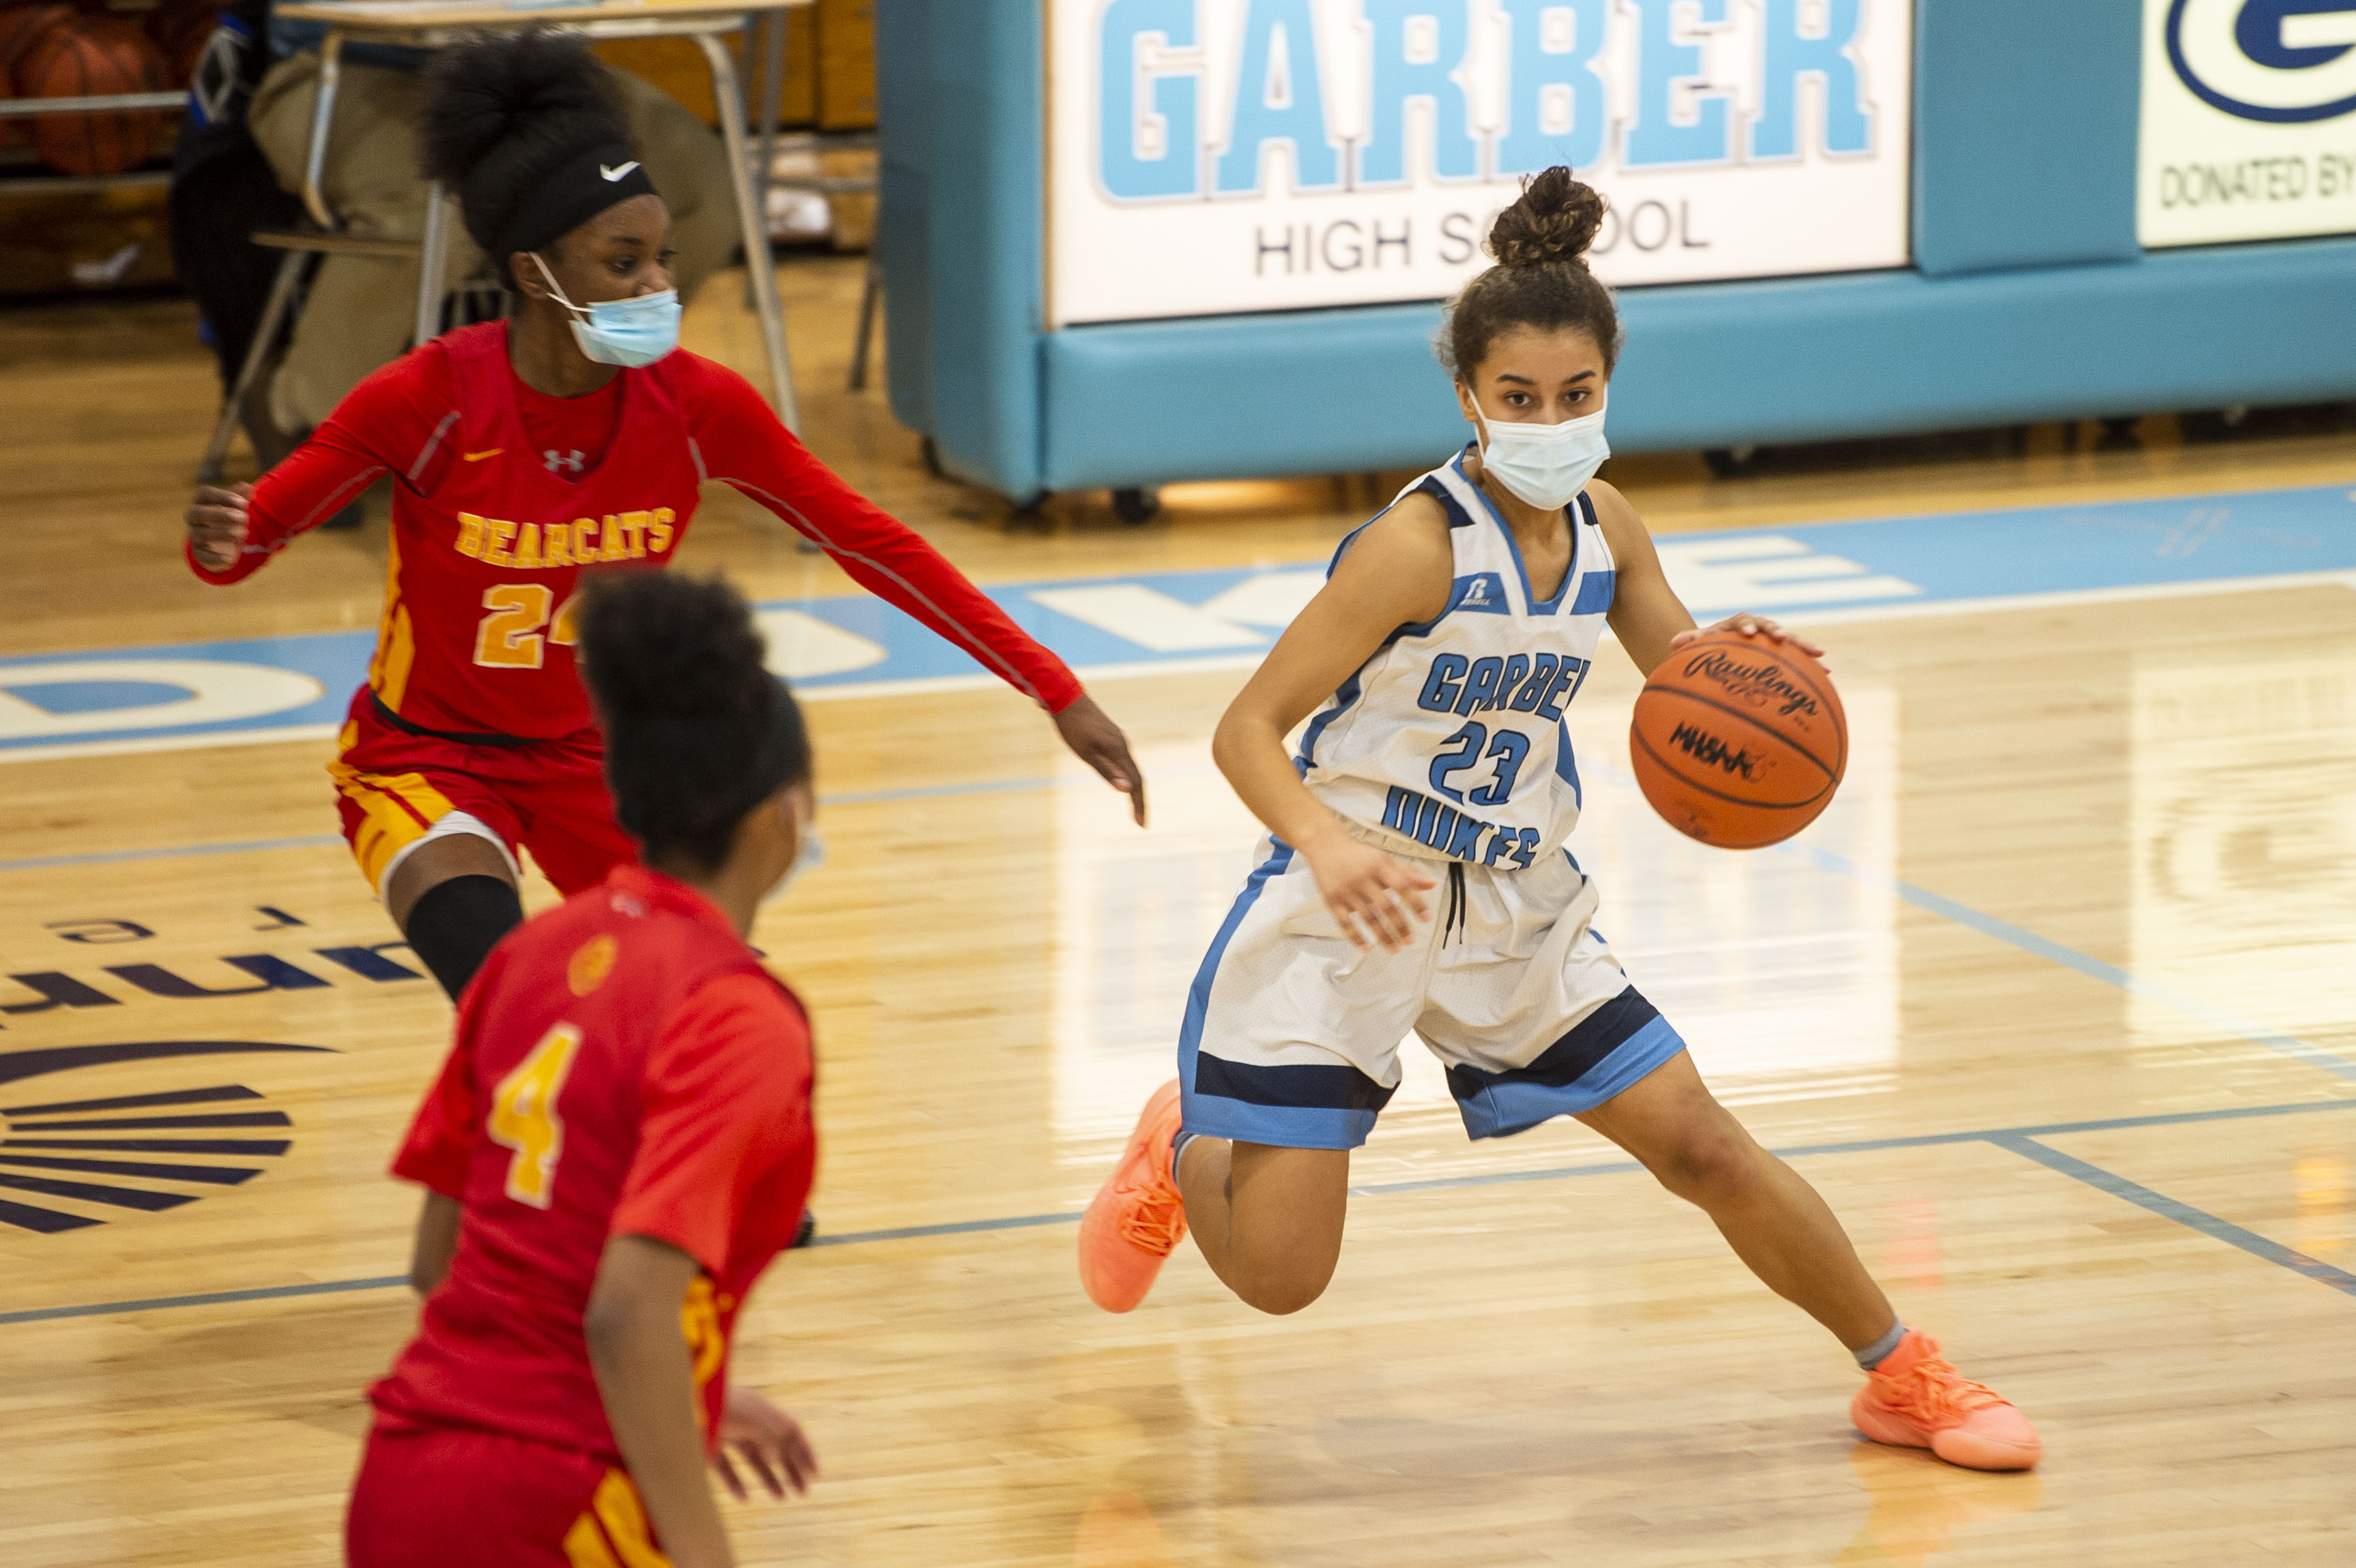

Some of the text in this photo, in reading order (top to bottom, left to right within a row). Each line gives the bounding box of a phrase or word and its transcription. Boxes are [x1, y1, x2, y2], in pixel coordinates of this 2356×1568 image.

[1097, 0, 1879, 202] GARBER
[2162, 156, 2306, 209] DONATED
[1256, 199, 1711, 276] HIGH SOOL
[454, 507, 676, 568] BEARCATS
[1683, 650, 1819, 717] Rawlings
[1429, 720, 1530, 807] 23
[486, 1021, 583, 1212] 4
